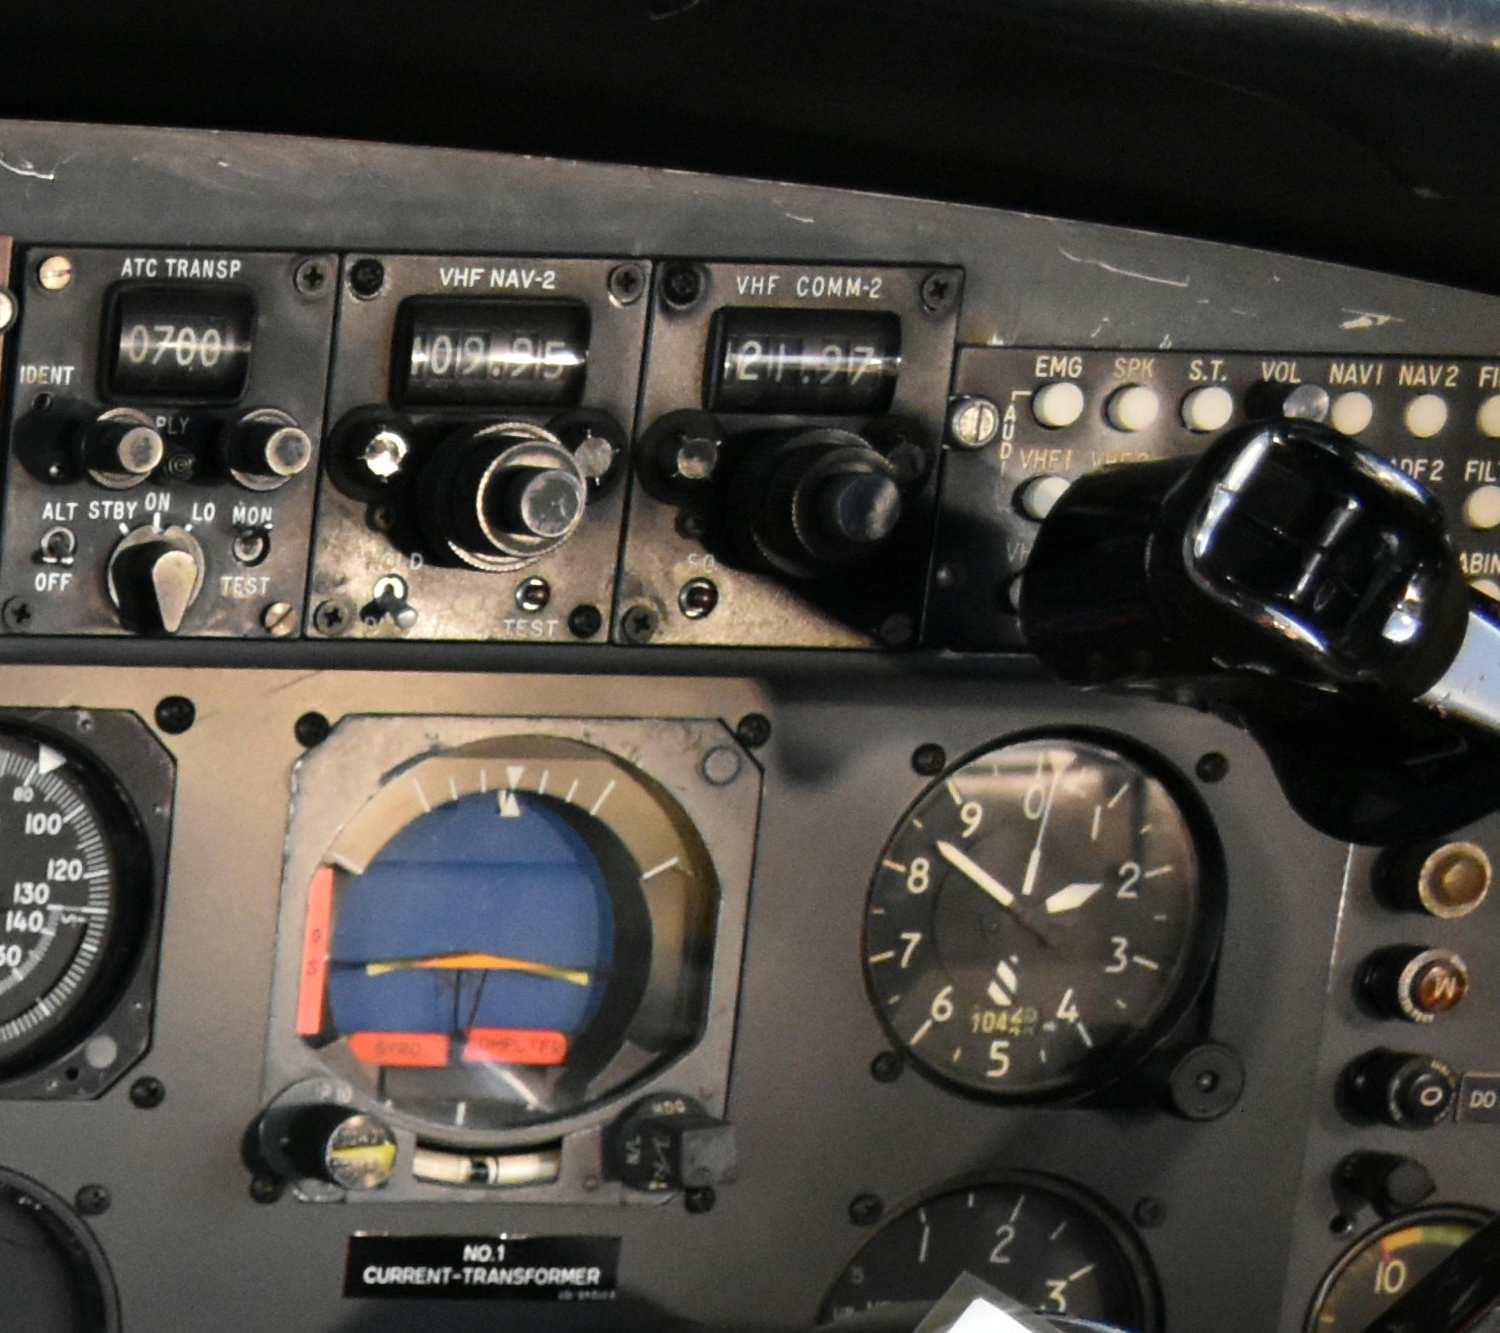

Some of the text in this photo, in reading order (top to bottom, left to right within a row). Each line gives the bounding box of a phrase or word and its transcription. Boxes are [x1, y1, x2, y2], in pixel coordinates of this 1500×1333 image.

[120, 257, 242, 279] ATC TRANSP
[439, 267, 556, 290] VHF NAV-2
[736, 274, 883, 299] VHF COMM-2
[19, 364, 76, 385] IDENT
[1035, 354, 1083, 379] EMG
[41, 501, 79, 521] ALT
[88, 500, 139, 521] STBY
[34, 571, 73, 592] OFF
[220, 576, 271, 599] TEST
[362, 1265, 601, 1286] CURRENT-TRANSFORMER
